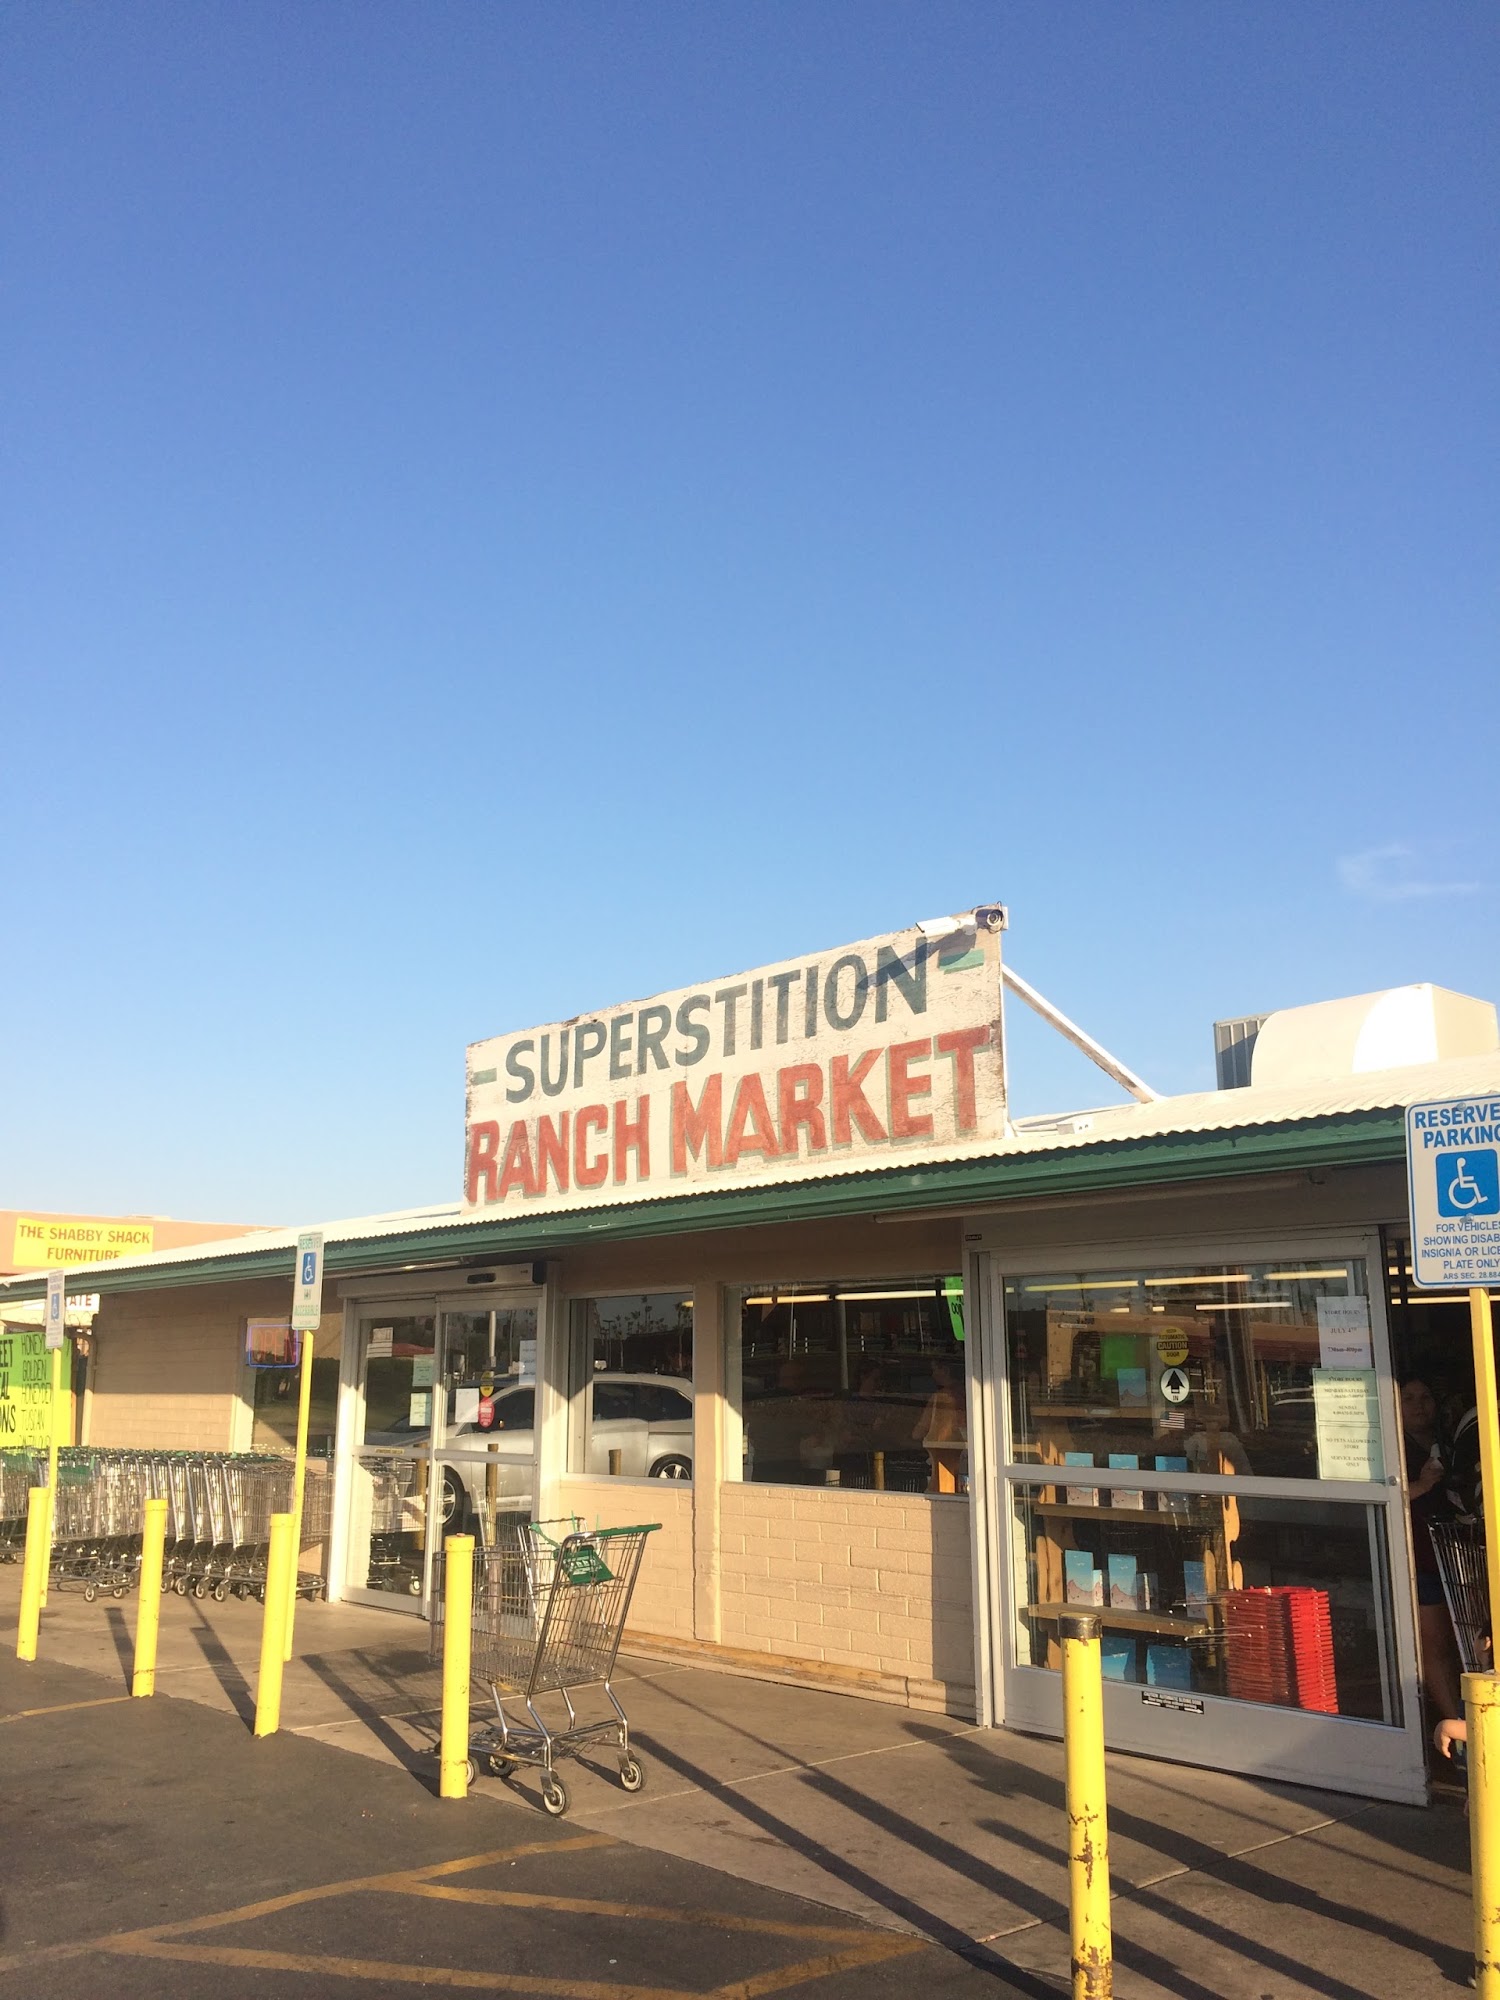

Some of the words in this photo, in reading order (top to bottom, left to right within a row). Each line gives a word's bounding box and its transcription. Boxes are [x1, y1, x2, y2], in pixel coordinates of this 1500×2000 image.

[505, 937, 927, 1104] SUPERSTITION
[467, 1094, 650, 1206] RANCH
[670, 1025, 991, 1179] MARKET
[1436, 1223, 1456, 1233] FOR
[1457, 1221, 1500, 1231] VEHICLE
[19, 1225, 45, 1239] THE
[49, 1227, 103, 1242] SHABBY
[107, 1230, 150, 1244] SHACK
[1424, 1235, 1468, 1246] SHOWING
[1422, 1247, 1461, 1258] INSIGNIA
[1465, 1246, 1479, 1257] OR
[1443, 1260, 1474, 1270] PLATE
[1476, 1258, 1500, 1269] ONLY
[1443, 1272, 1459, 1280] ARS
[1157, 1341, 1188, 1350] CAUTION
[22, 1359, 47, 1382] GOLDEN
[21, 1382, 53, 1405] HONEYDE
